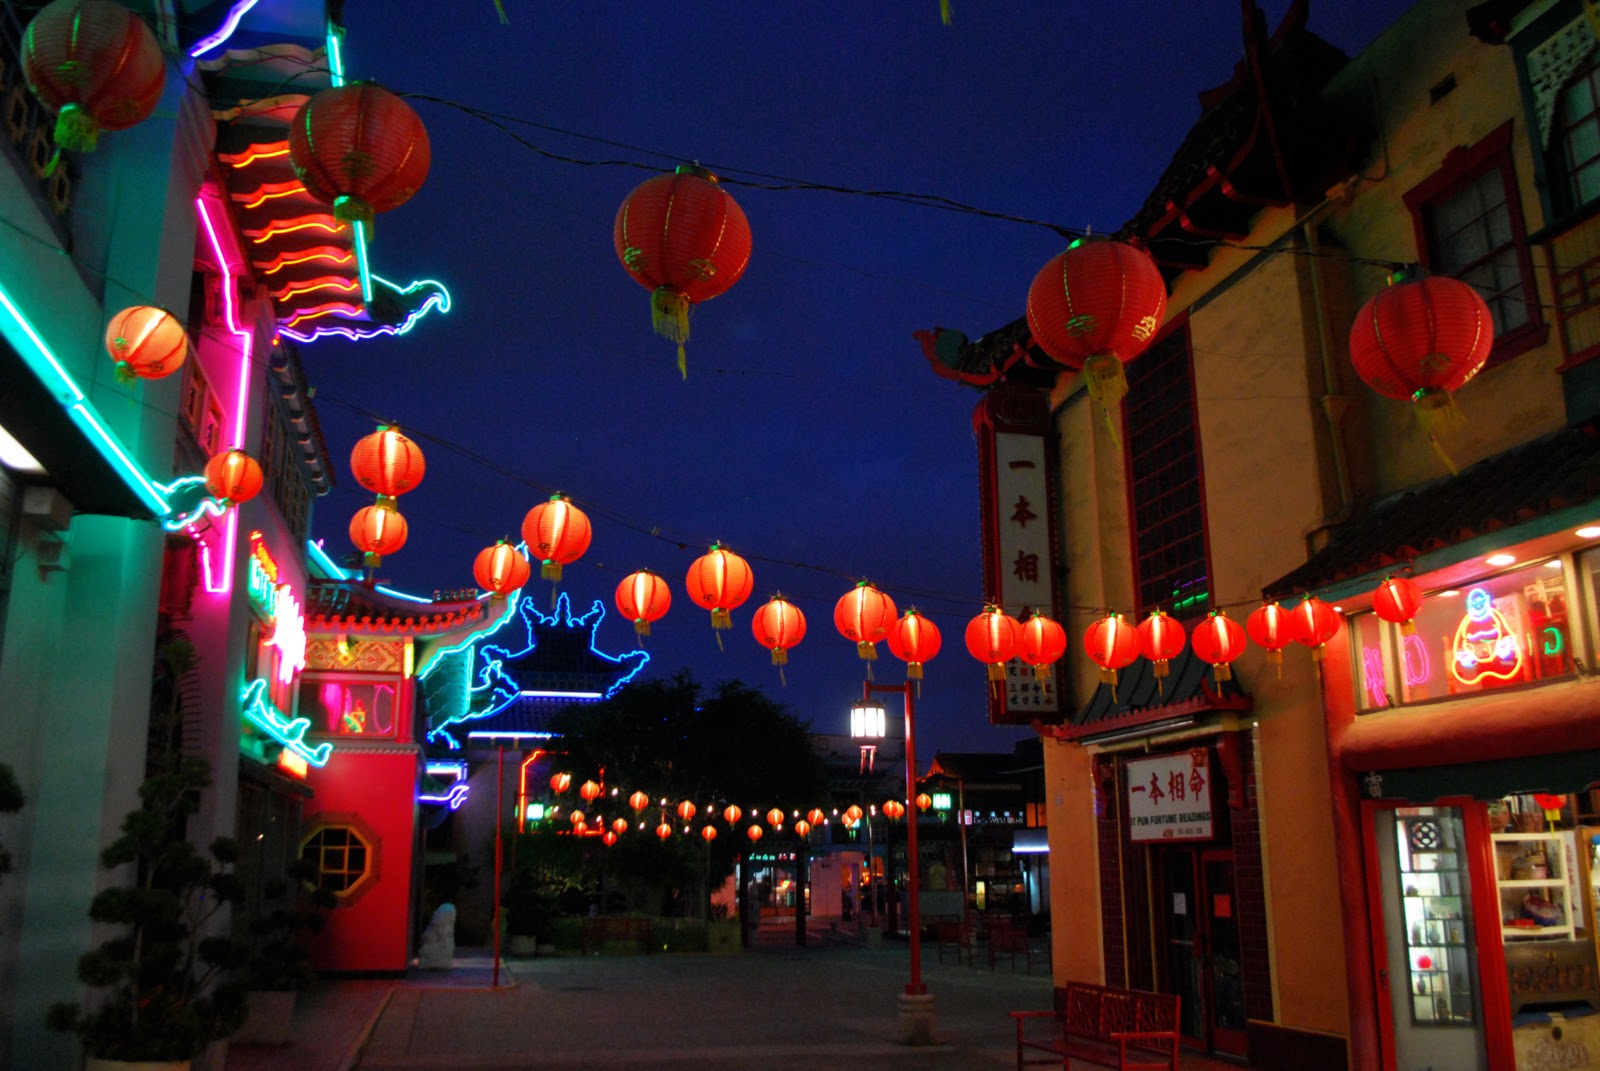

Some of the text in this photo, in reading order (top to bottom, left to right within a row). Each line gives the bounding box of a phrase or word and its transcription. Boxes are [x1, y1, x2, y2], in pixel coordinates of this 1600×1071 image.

[1131, 767, 1206, 806] 一本相命
[1138, 815, 1149, 826] PUN
[1150, 813, 1178, 825] FORTUNE
[1179, 811, 1210, 823] READINGS
